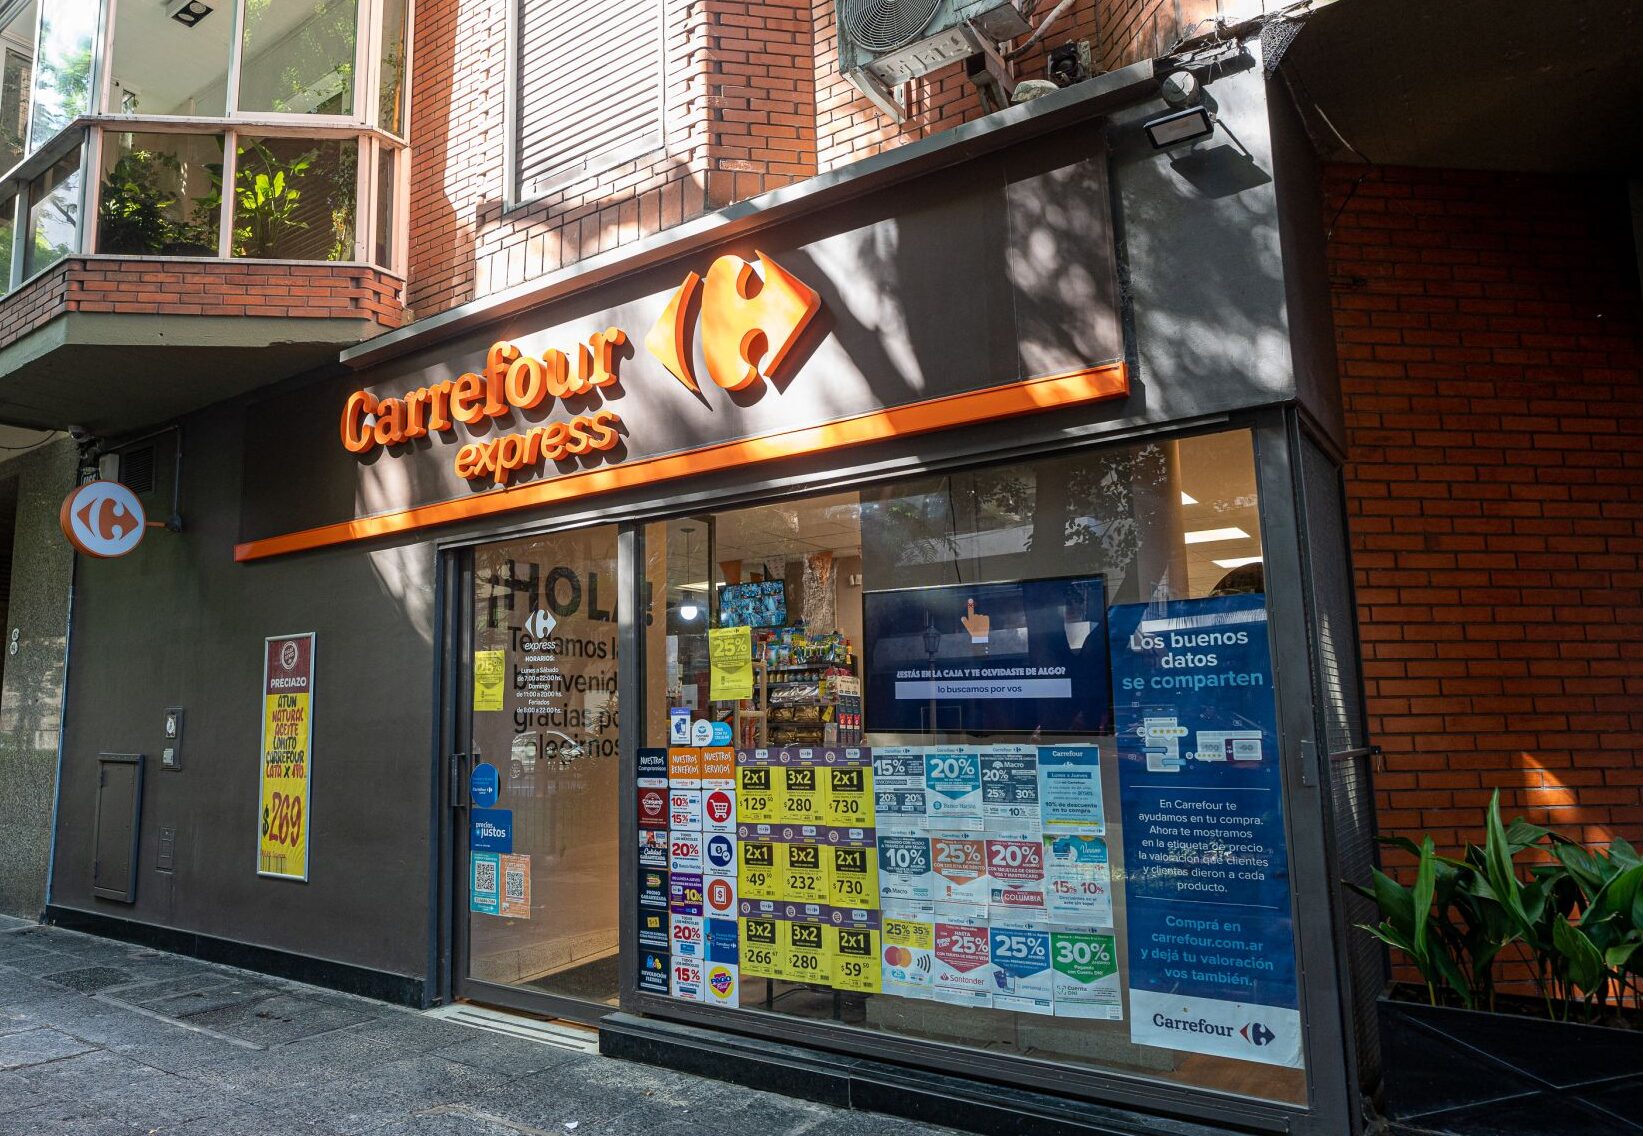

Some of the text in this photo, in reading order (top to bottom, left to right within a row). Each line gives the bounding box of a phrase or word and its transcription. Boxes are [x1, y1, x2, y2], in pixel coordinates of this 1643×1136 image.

[341, 326, 626, 453] Carrefour
[454, 410, 621, 483] express
[525, 642, 556, 652] express
[713, 638, 747, 656] 25%
[1130, 631, 1248, 650] Los buenos
[1162, 653, 1218, 668] datos
[514, 664, 618, 694] bienvenid
[933, 669, 943, 678] LA
[944, 668, 963, 678] CAJA
[971, 669, 980, 677] TE
[981, 667, 1025, 677] OLVIDASTE
[1026, 667, 1037, 676] DE
[1038, 667, 1066, 676] ALGO?
[271, 677, 307, 688] PRECIAZO
[1123, 671, 1263, 691] se comparten
[938, 685, 946, 694] lo
[947, 685, 989, 693] buscamos
[990, 685, 1006, 694] por
[275, 723, 298, 736] ACEITE
[266, 750, 304, 764] CARREFOUR
[641, 756, 664, 765] NUESTROS
[704, 752, 731, 761] NUESTROS
[874, 760, 905, 775] 15%
[930, 759, 975, 778] 20%
[982, 769, 1008, 781] 20%
[744, 771, 766, 783] 2x1
[788, 771, 811, 783] 3x2
[834, 772, 858, 785] 2x1
[1160, 799, 1236, 810] En Carrefour te
[1139, 813, 1263, 826] ayudamos en tu compra.
[481, 826, 506, 838] justos
[1149, 826, 1252, 838] Ahora te mostramos
[672, 844, 699, 857] 20%
[746, 846, 768, 859] 2x1
[936, 843, 981, 864] 25%
[1142, 838, 1263, 855] en la etiqueta de precio
[791, 847, 815, 862] 3x2
[837, 852, 860, 866] 2x1
[886, 849, 925, 867] 10%
[991, 845, 1039, 867] 20%
[1138, 851, 1268, 867] la valoración que clientes
[1143, 867, 1149, 875] y
[1152, 866, 1188, 876] clientas
[1191, 869, 1225, 878] dieron
[1238, 871, 1264, 881] cada
[684, 889, 702, 900] 10%
[1053, 881, 1077, 893] 15%
[1081, 882, 1104, 894] 10%
[1177, 882, 1228, 893] producto.
[1004, 894, 1041, 902] COLUMBIA
[749, 922, 771, 937] 3x2
[886, 923, 910, 935] 25%
[1166, 916, 1241, 932] Comprá en
[674, 925, 700, 940] 20%
[793, 926, 818, 941] 3x2
[841, 933, 864, 947] 2x1
[951, 936, 988, 953] 25%
[995, 935, 1045, 957] 25%
[1152, 932, 1263, 952] carrefour.com.ar
[1056, 941, 1110, 964] 30%
[1141, 949, 1274, 971] y dejá tu valoración
[675, 967, 700, 982] 15%
[950, 975, 984, 985] Santander
[1165, 968, 1253, 986] vos también.
[1153, 1014, 1234, 1037] Carrefour
